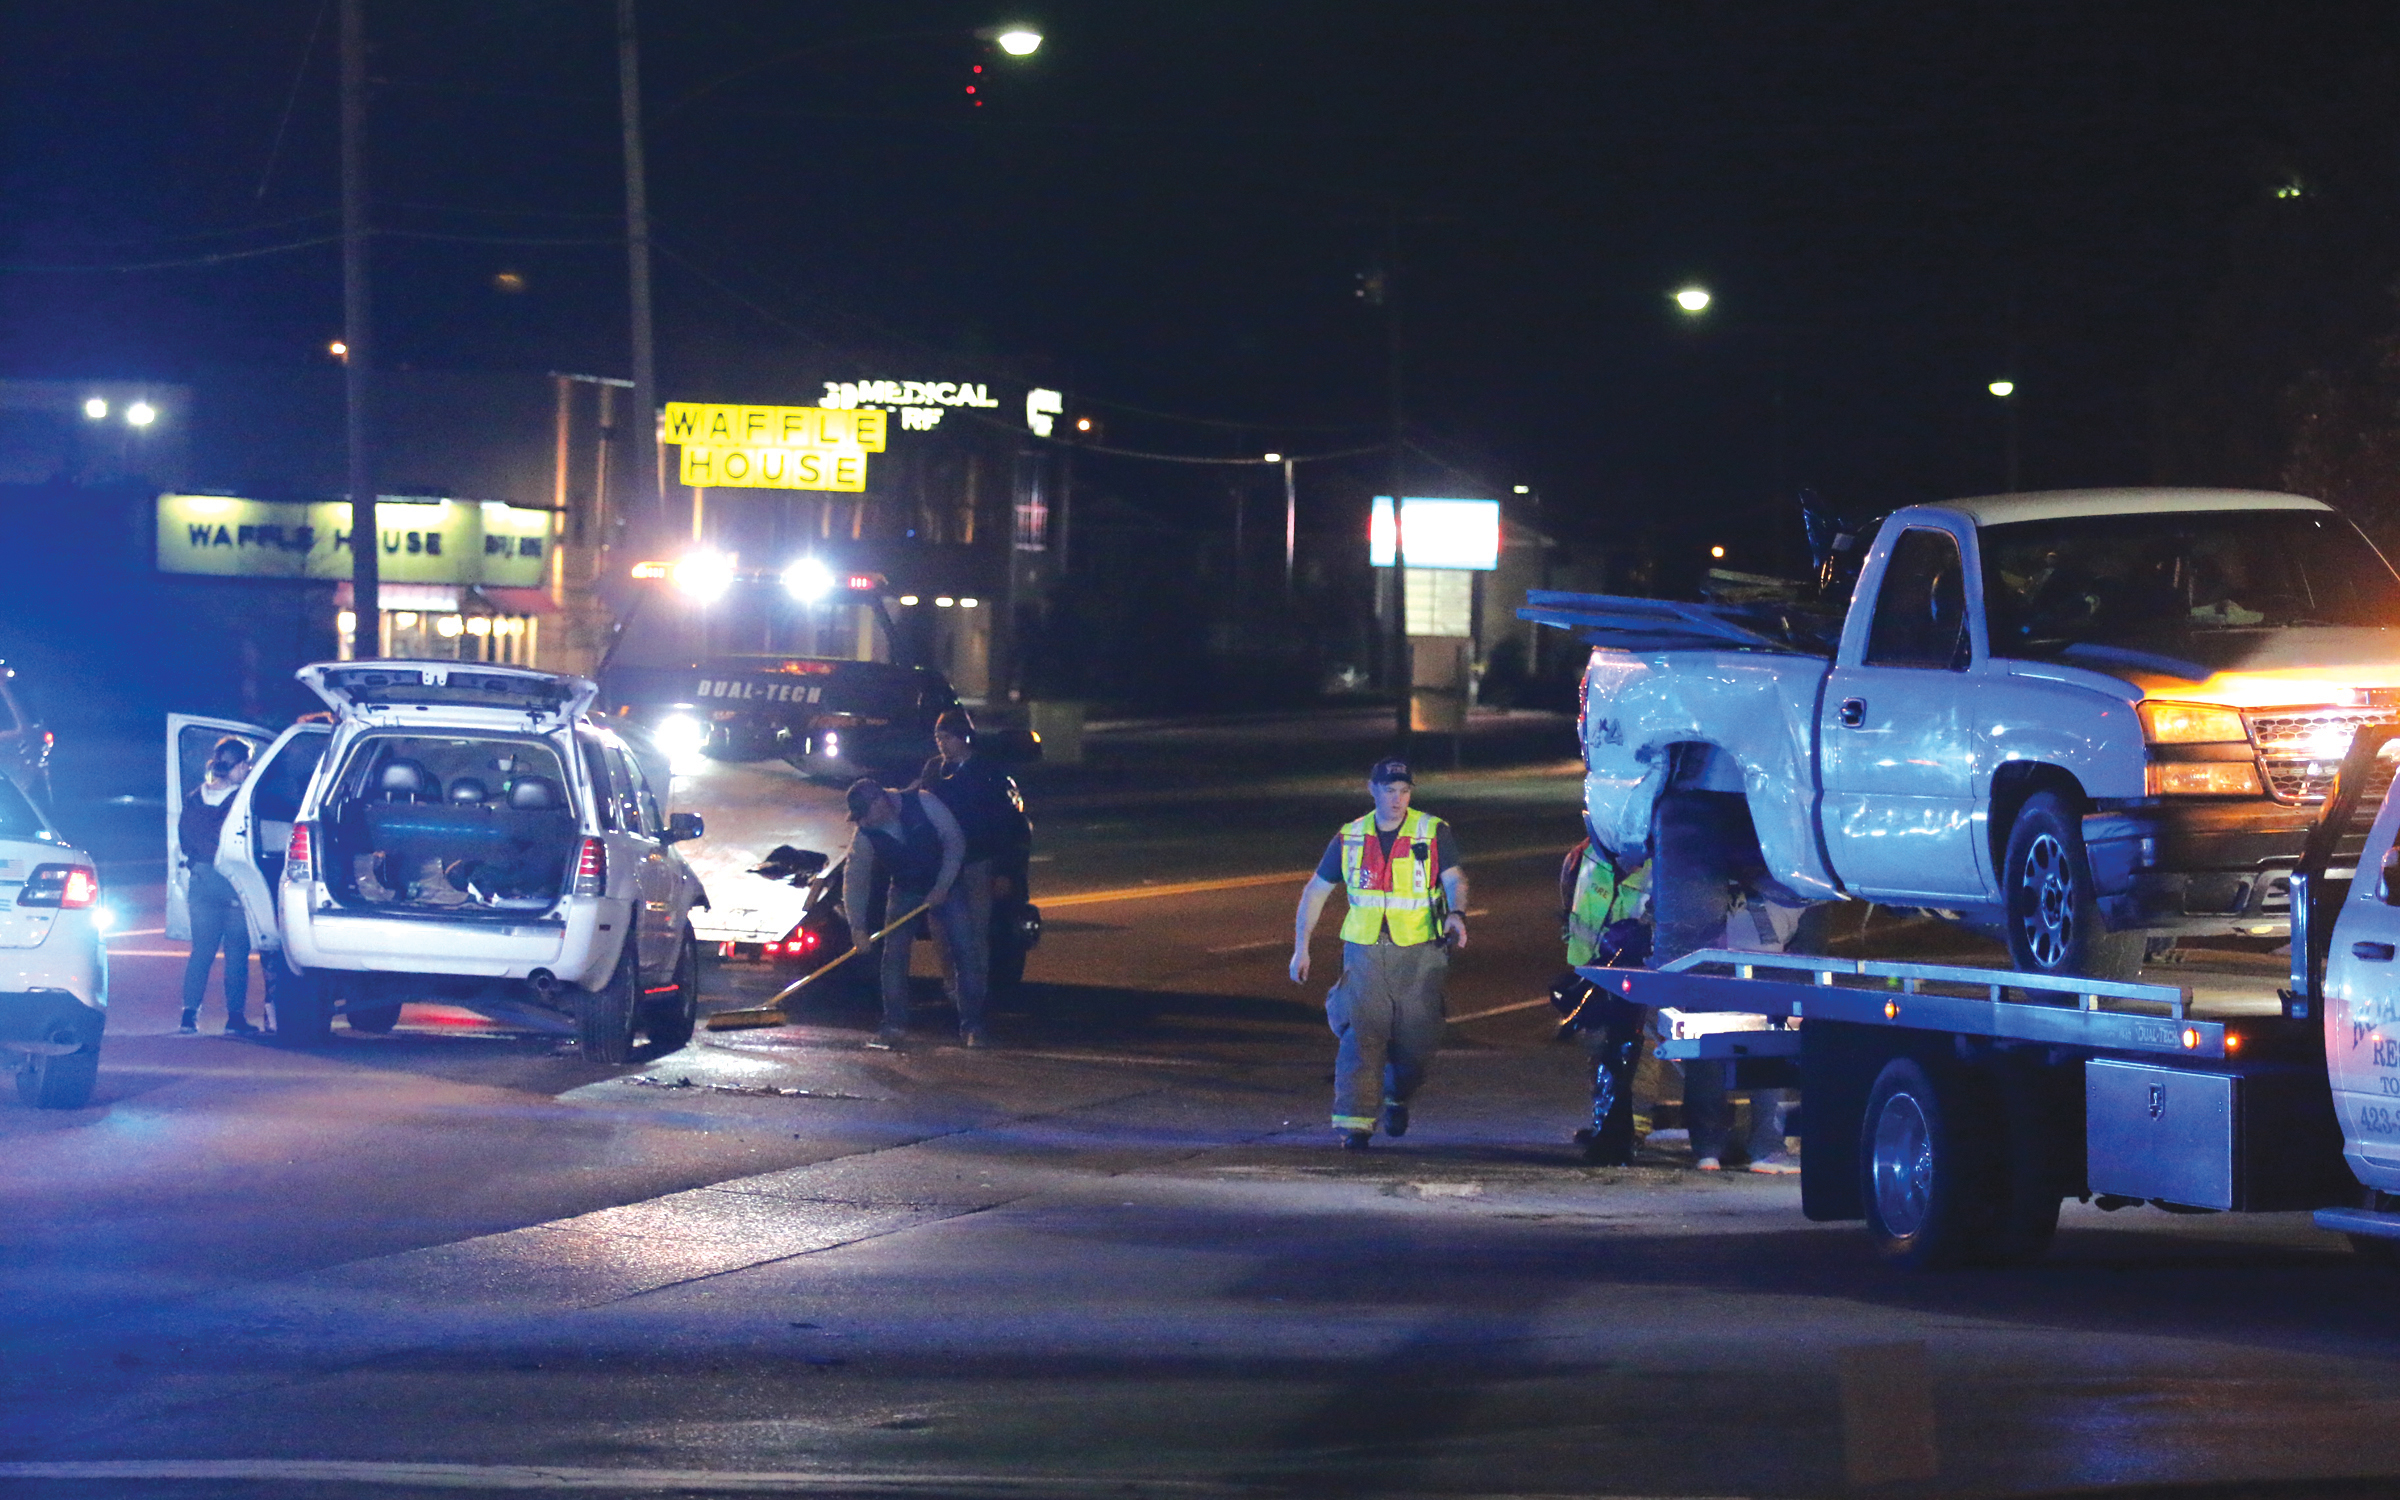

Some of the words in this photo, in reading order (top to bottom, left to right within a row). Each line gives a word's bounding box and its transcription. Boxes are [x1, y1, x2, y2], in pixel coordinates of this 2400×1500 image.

[857, 380, 999, 408] MEDICAL
[671, 410, 876, 443] WAFFLE
[690, 452, 857, 484] HOUSE
[334, 529, 442, 556] HUSE
[698, 679, 821, 704] DUAL-TECH
[2373, 1038, 2400, 1067] RE
[2380, 1076, 2400, 1095] TO
